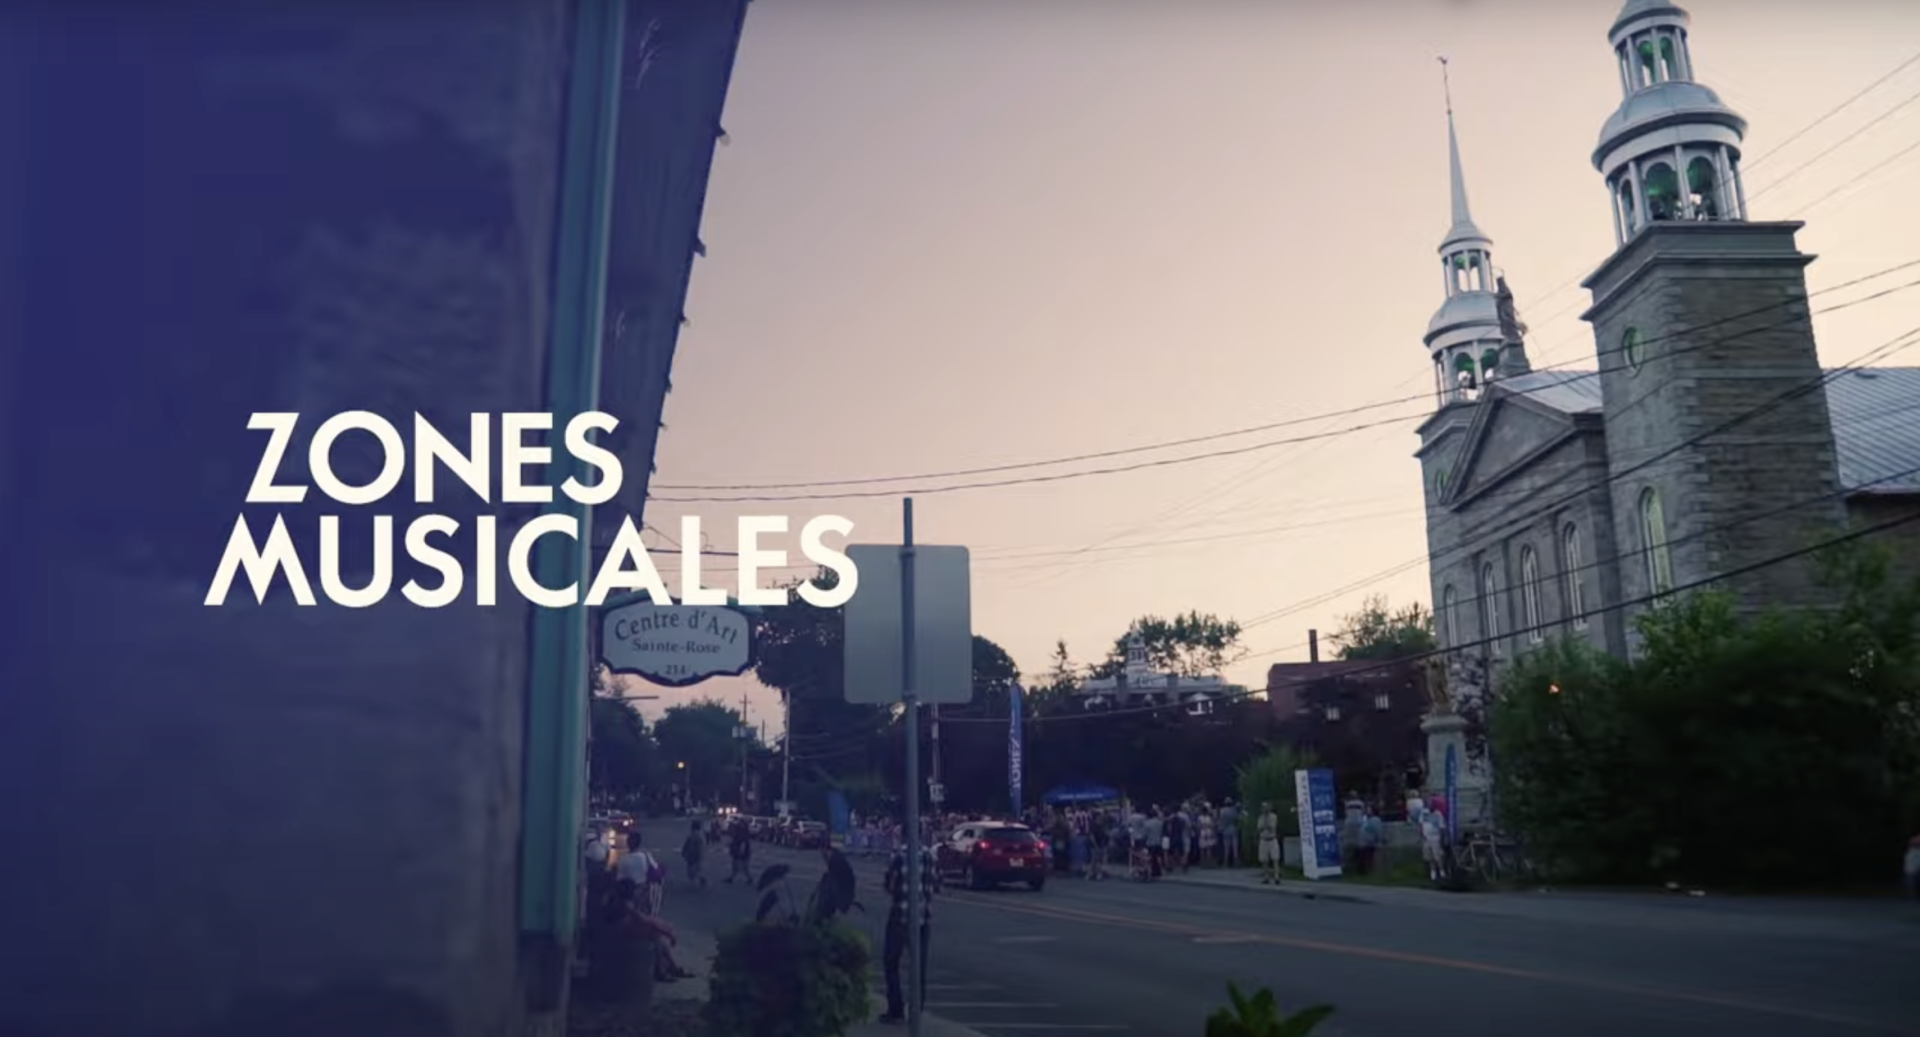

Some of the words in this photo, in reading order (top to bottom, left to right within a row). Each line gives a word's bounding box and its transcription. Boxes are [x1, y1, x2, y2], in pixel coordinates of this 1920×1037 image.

[615, 611, 680, 641] Centre
[688, 609, 738, 645] d'Art
[632, 638, 721, 653] Sainte-Rose
